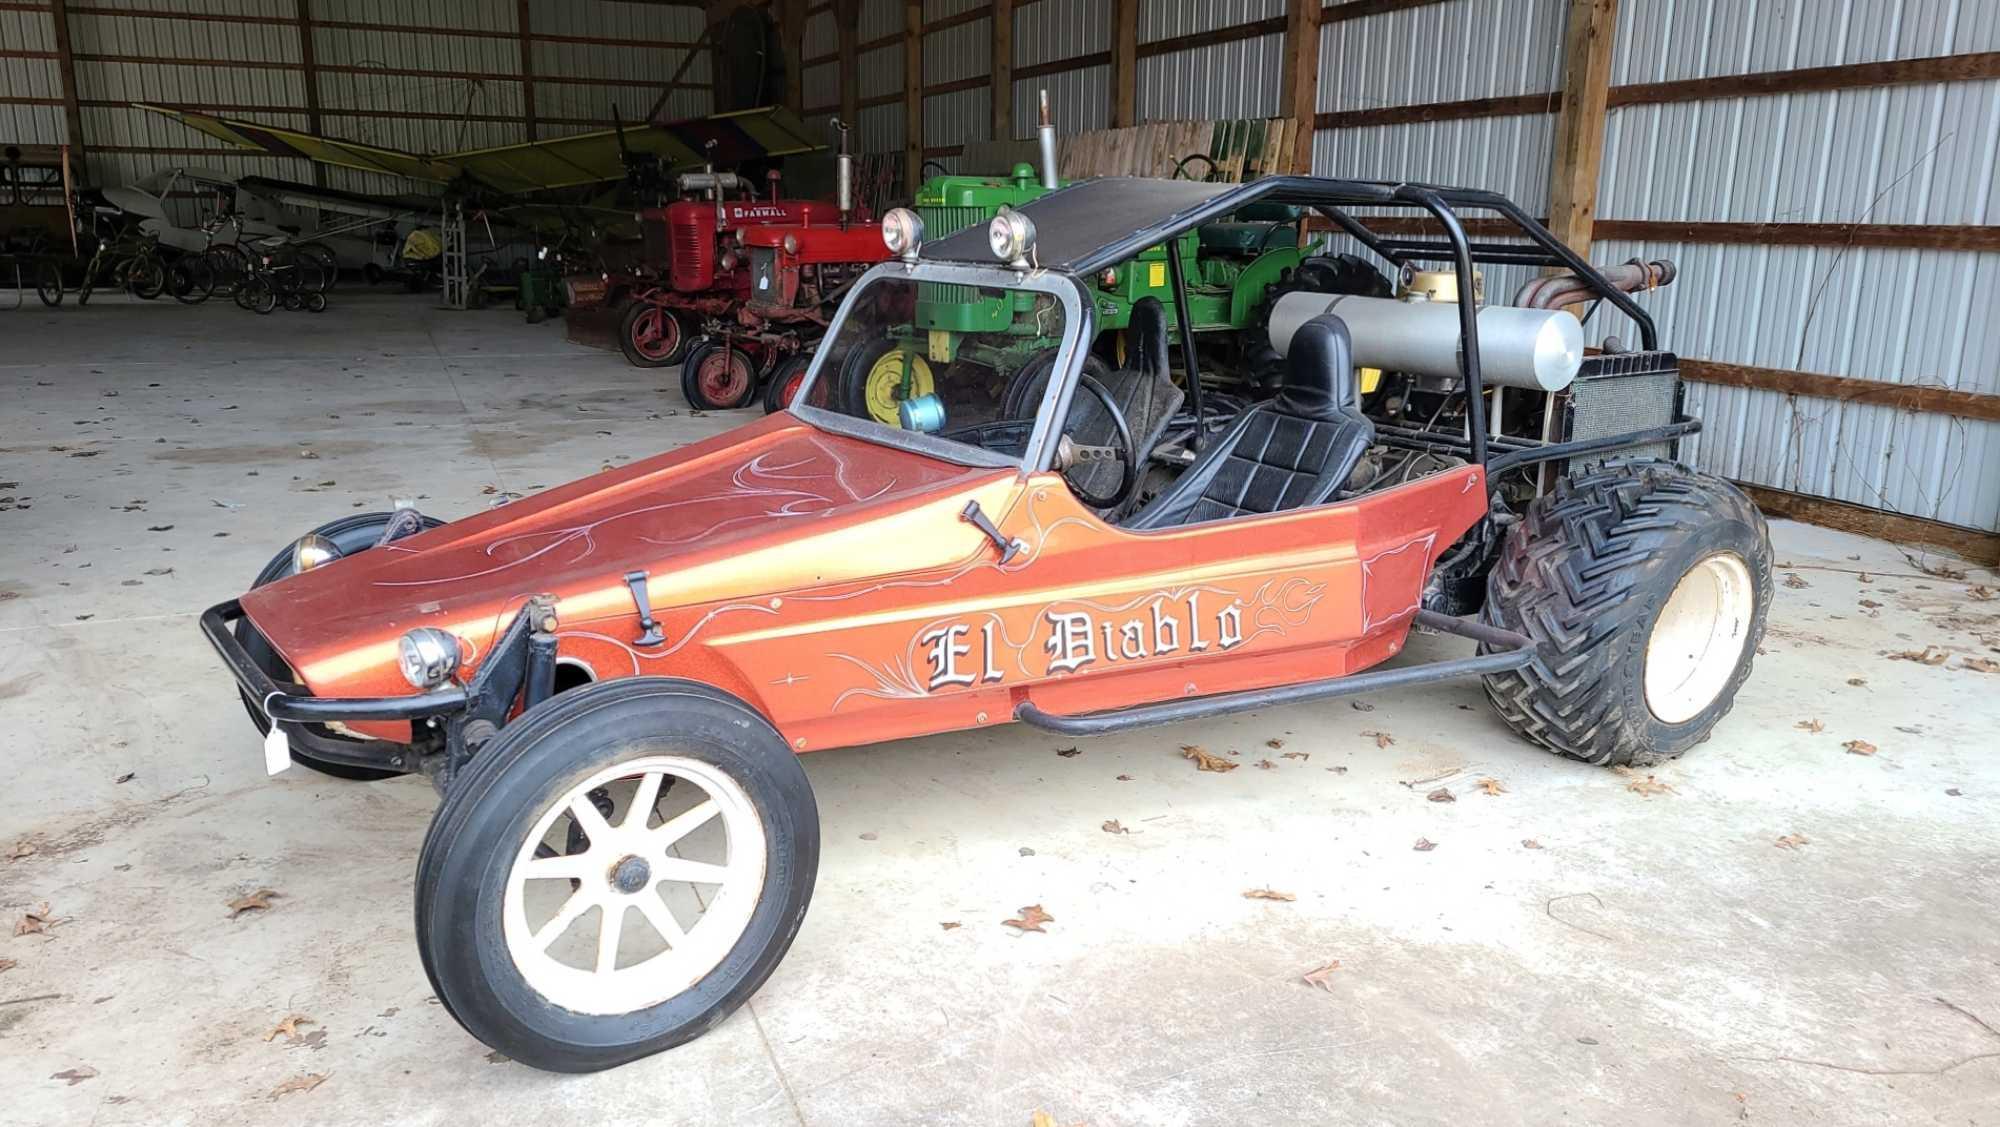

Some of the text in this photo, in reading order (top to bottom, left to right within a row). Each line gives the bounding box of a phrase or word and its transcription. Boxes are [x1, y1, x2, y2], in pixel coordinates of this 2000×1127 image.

[744, 209, 787, 217] FARMALL
[922, 592, 1244, 692] El Diablo
